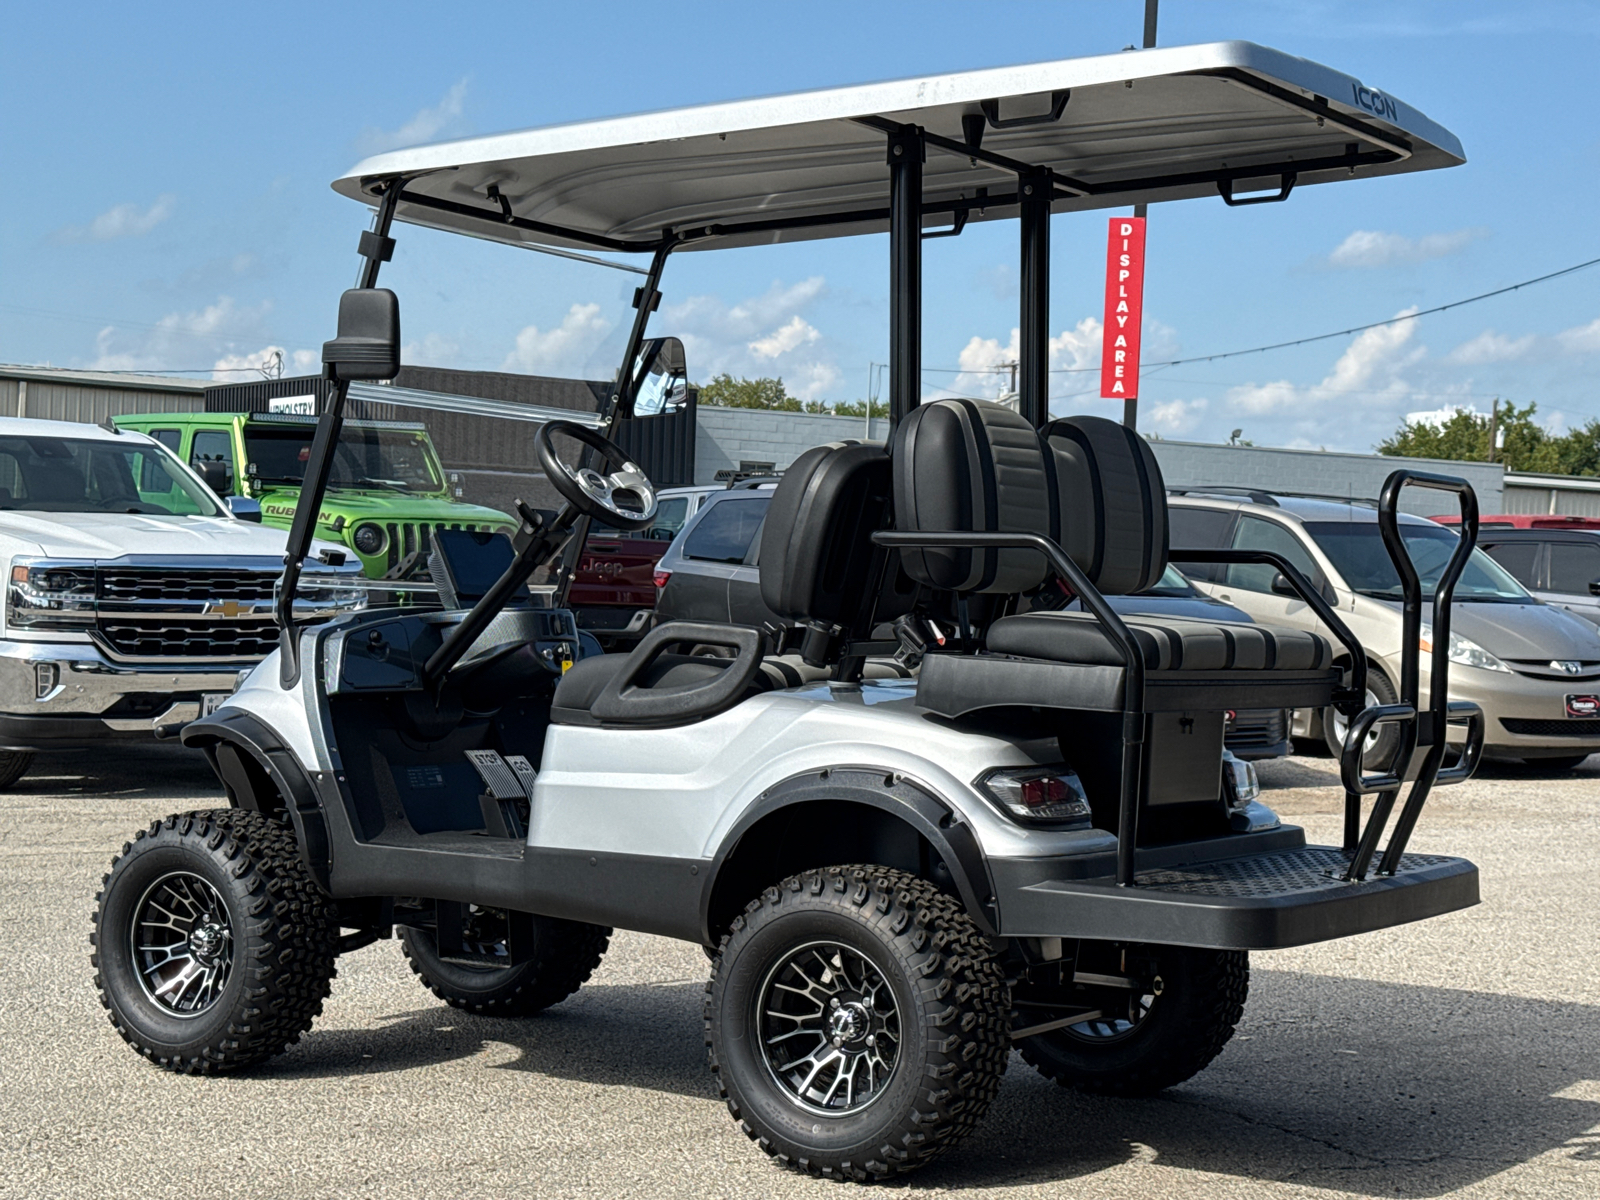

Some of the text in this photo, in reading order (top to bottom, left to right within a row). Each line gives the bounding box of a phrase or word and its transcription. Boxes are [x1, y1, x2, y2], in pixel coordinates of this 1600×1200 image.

[1352, 83, 1397, 121] ICON
[1111, 223, 1133, 393] DISPLAY AREA
[265, 505, 332, 520] RUBN
[583, 558, 624, 577] Jeep
[475, 753, 498, 765] STOP
[514, 760, 530, 771] GO
